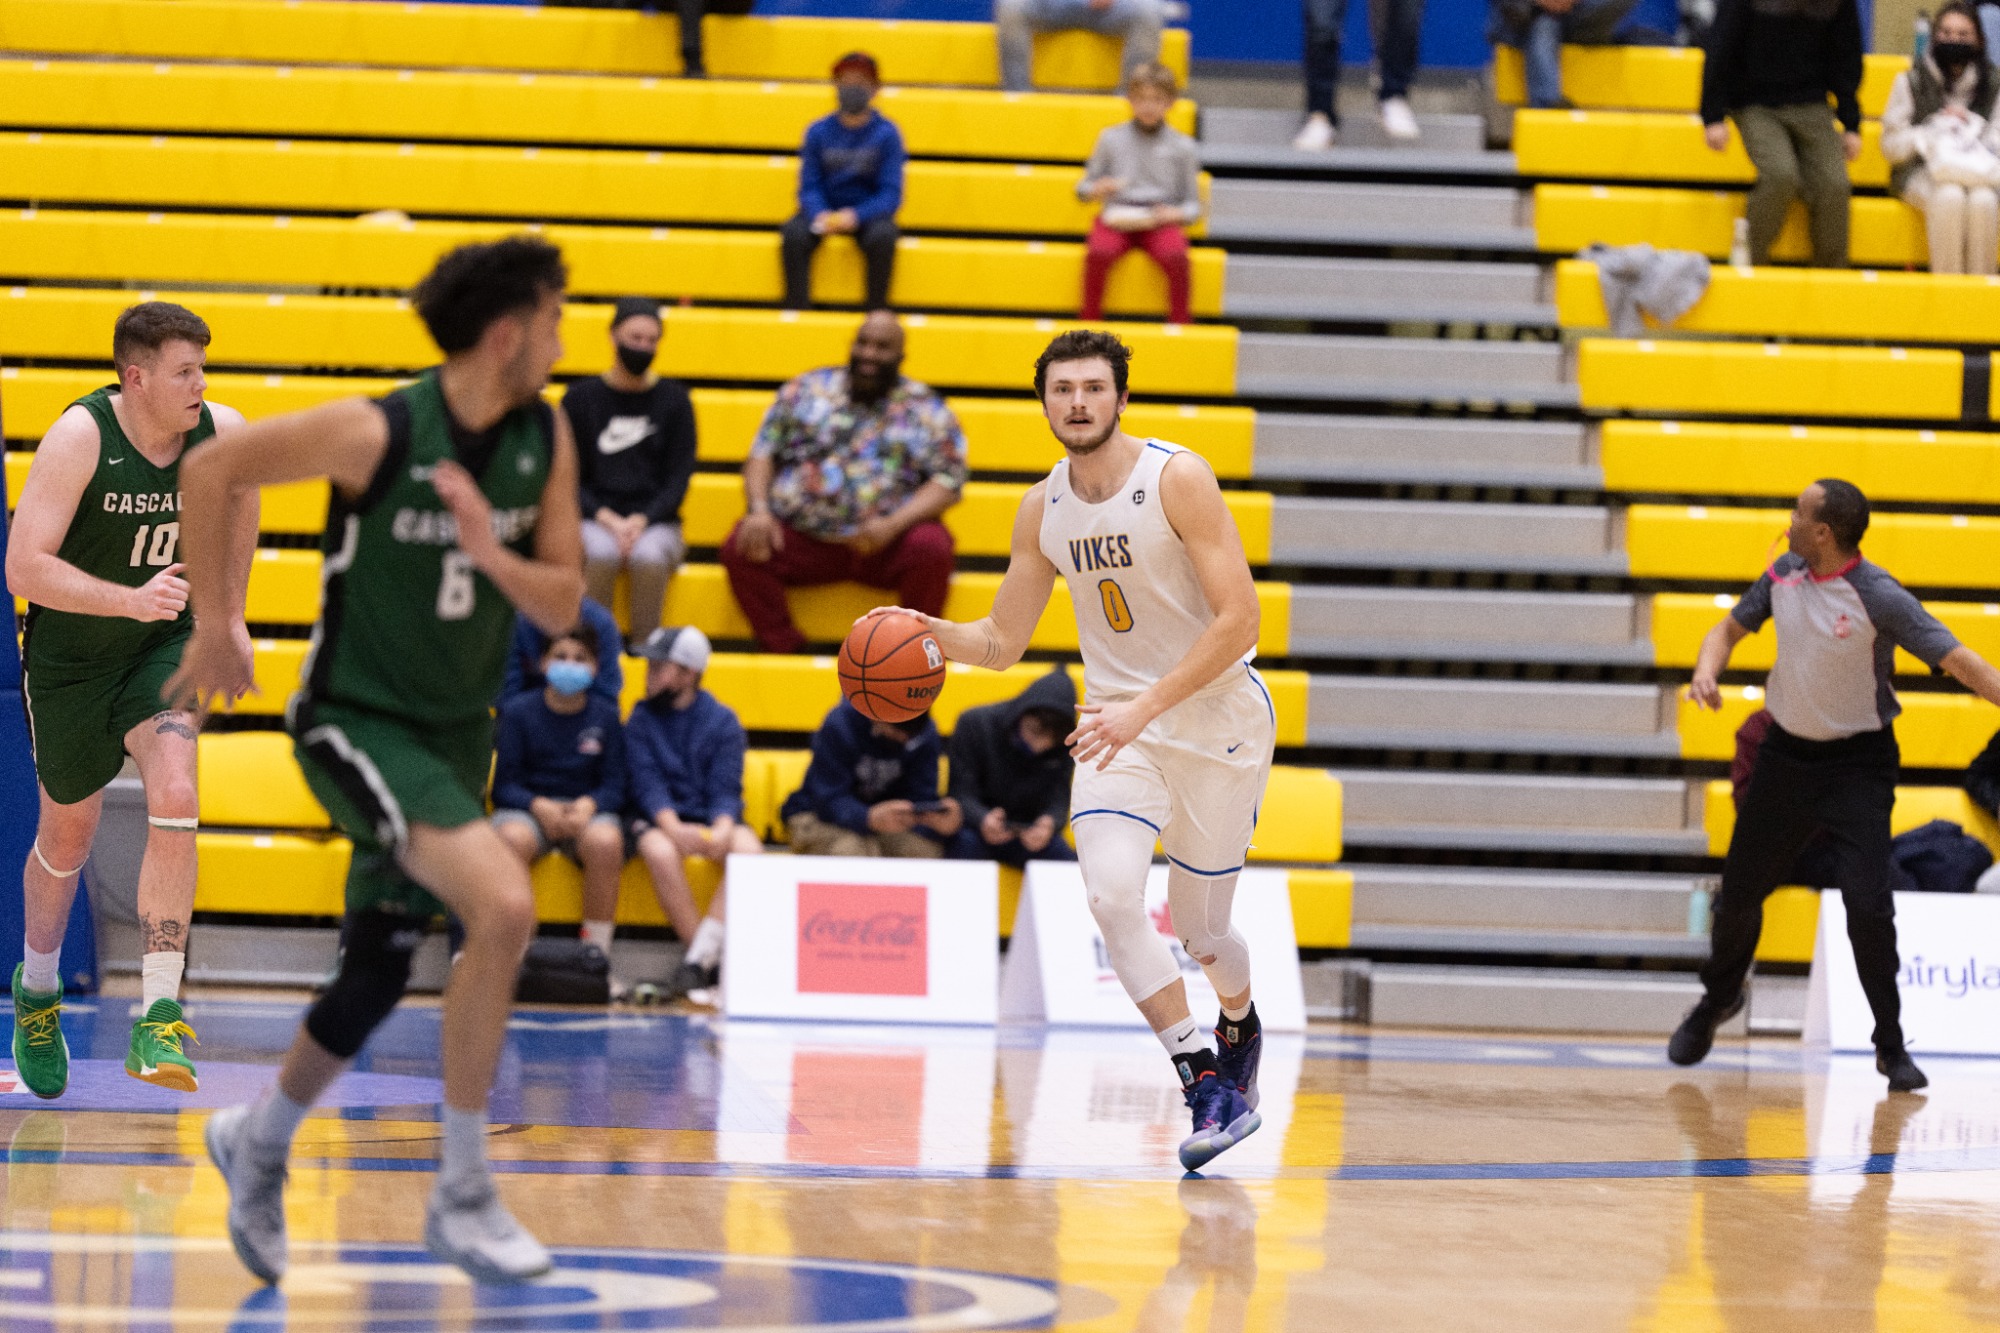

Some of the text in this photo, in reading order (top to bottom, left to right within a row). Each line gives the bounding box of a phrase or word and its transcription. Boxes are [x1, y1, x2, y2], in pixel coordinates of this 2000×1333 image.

[103, 491, 184, 514] CASCA
[129, 521, 180, 567] 10
[1068, 533, 1134, 573] VIKES
[436, 551, 476, 621] 6
[1098, 578, 1135, 633] 0
[1898, 954, 2000, 999] airyla
